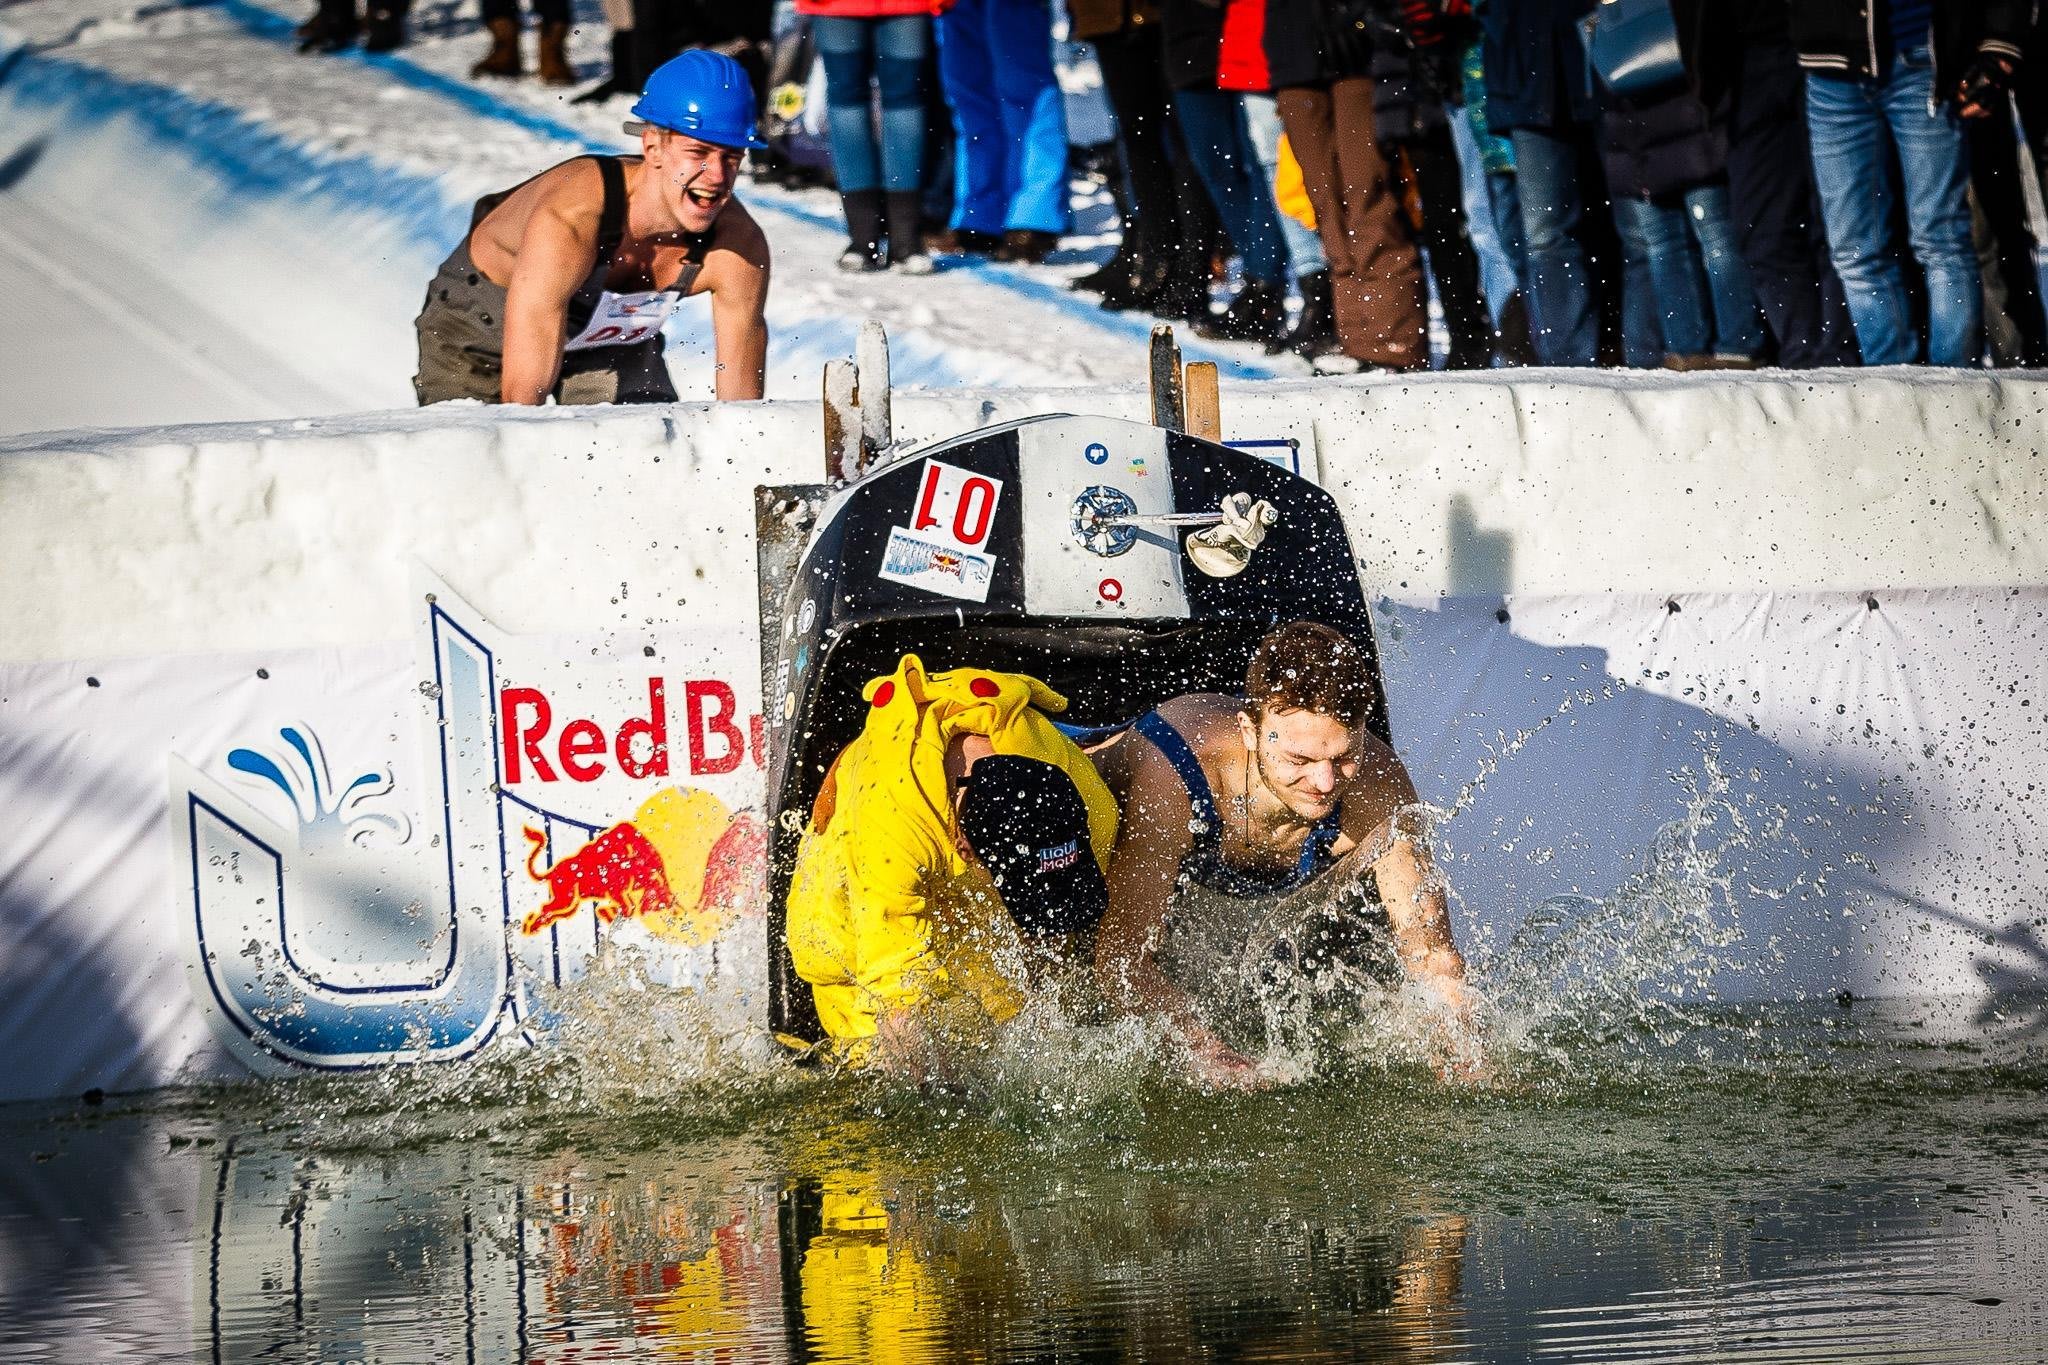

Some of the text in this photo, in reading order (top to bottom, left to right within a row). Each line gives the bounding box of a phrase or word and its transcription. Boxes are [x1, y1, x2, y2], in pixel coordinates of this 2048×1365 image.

[915, 465, 995, 545] 01
[500, 677, 669, 784] Red
[1043, 842, 1075, 860] LIQUI
